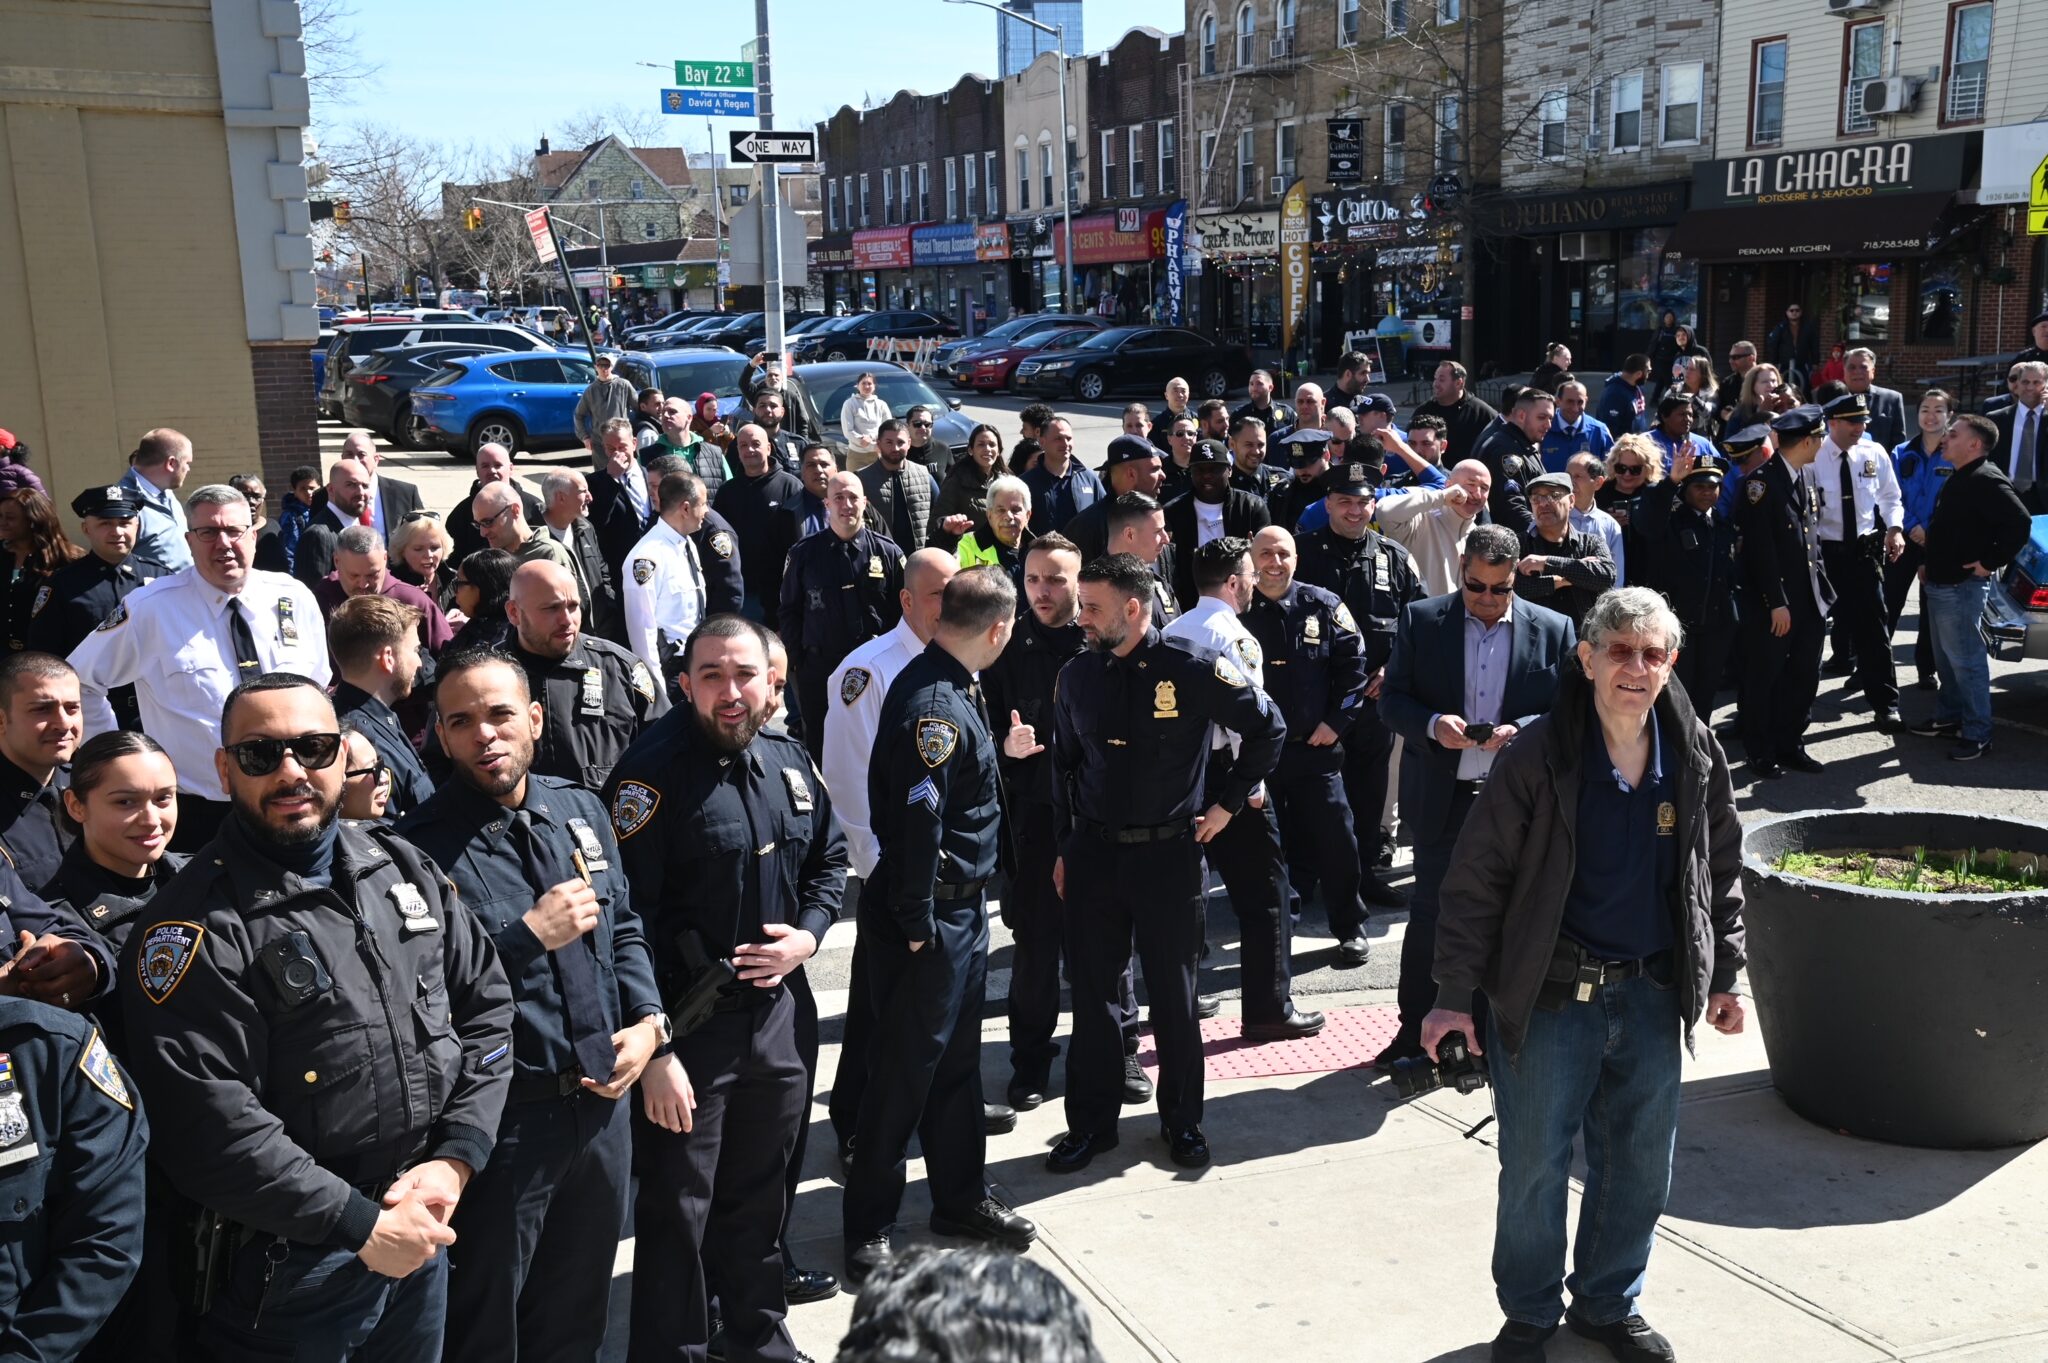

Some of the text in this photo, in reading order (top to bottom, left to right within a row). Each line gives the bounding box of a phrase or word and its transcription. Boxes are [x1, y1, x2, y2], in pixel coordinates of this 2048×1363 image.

[685, 65, 745, 87] Bay 22 St
[688, 98, 750, 110] David A Regan
[747, 141, 806, 154] ONE WAY
[1726, 143, 1913, 197] LA CHACRA
[1757, 187, 1873, 204] ROTISSERIE & SEAFOOD
[2003, 191, 2020, 200] Bath
[1515, 198, 1606, 231] JULIANO
[1283, 217, 1306, 229] FRESH
[1078, 232, 1105, 249] CENTS
[1109, 231, 1136, 248] STORE
[1202, 230, 1275, 249] CREPE FACTORY
[1283, 231, 1307, 242] HOT
[912, 239, 932, 255] Physical
[932, 238, 951, 255] Therapy
[1738, 244, 1831, 256] PERUVIAN KITCHEN
[1863, 239, 1920, 250] 718.758.5488
[1665, 251, 1682, 259] 1928
[930, 722, 949, 731] POLICE
[627, 784, 649, 796] POLICE
[619, 789, 653, 806] DEPARTMENT
[637, 809, 651, 824] YORK
[155, 926, 185, 936] POLICE
[144, 934, 192, 948] DEPARTMENT
[161, 951, 190, 993] NEW YORK
[144, 977, 153, 989] OF
